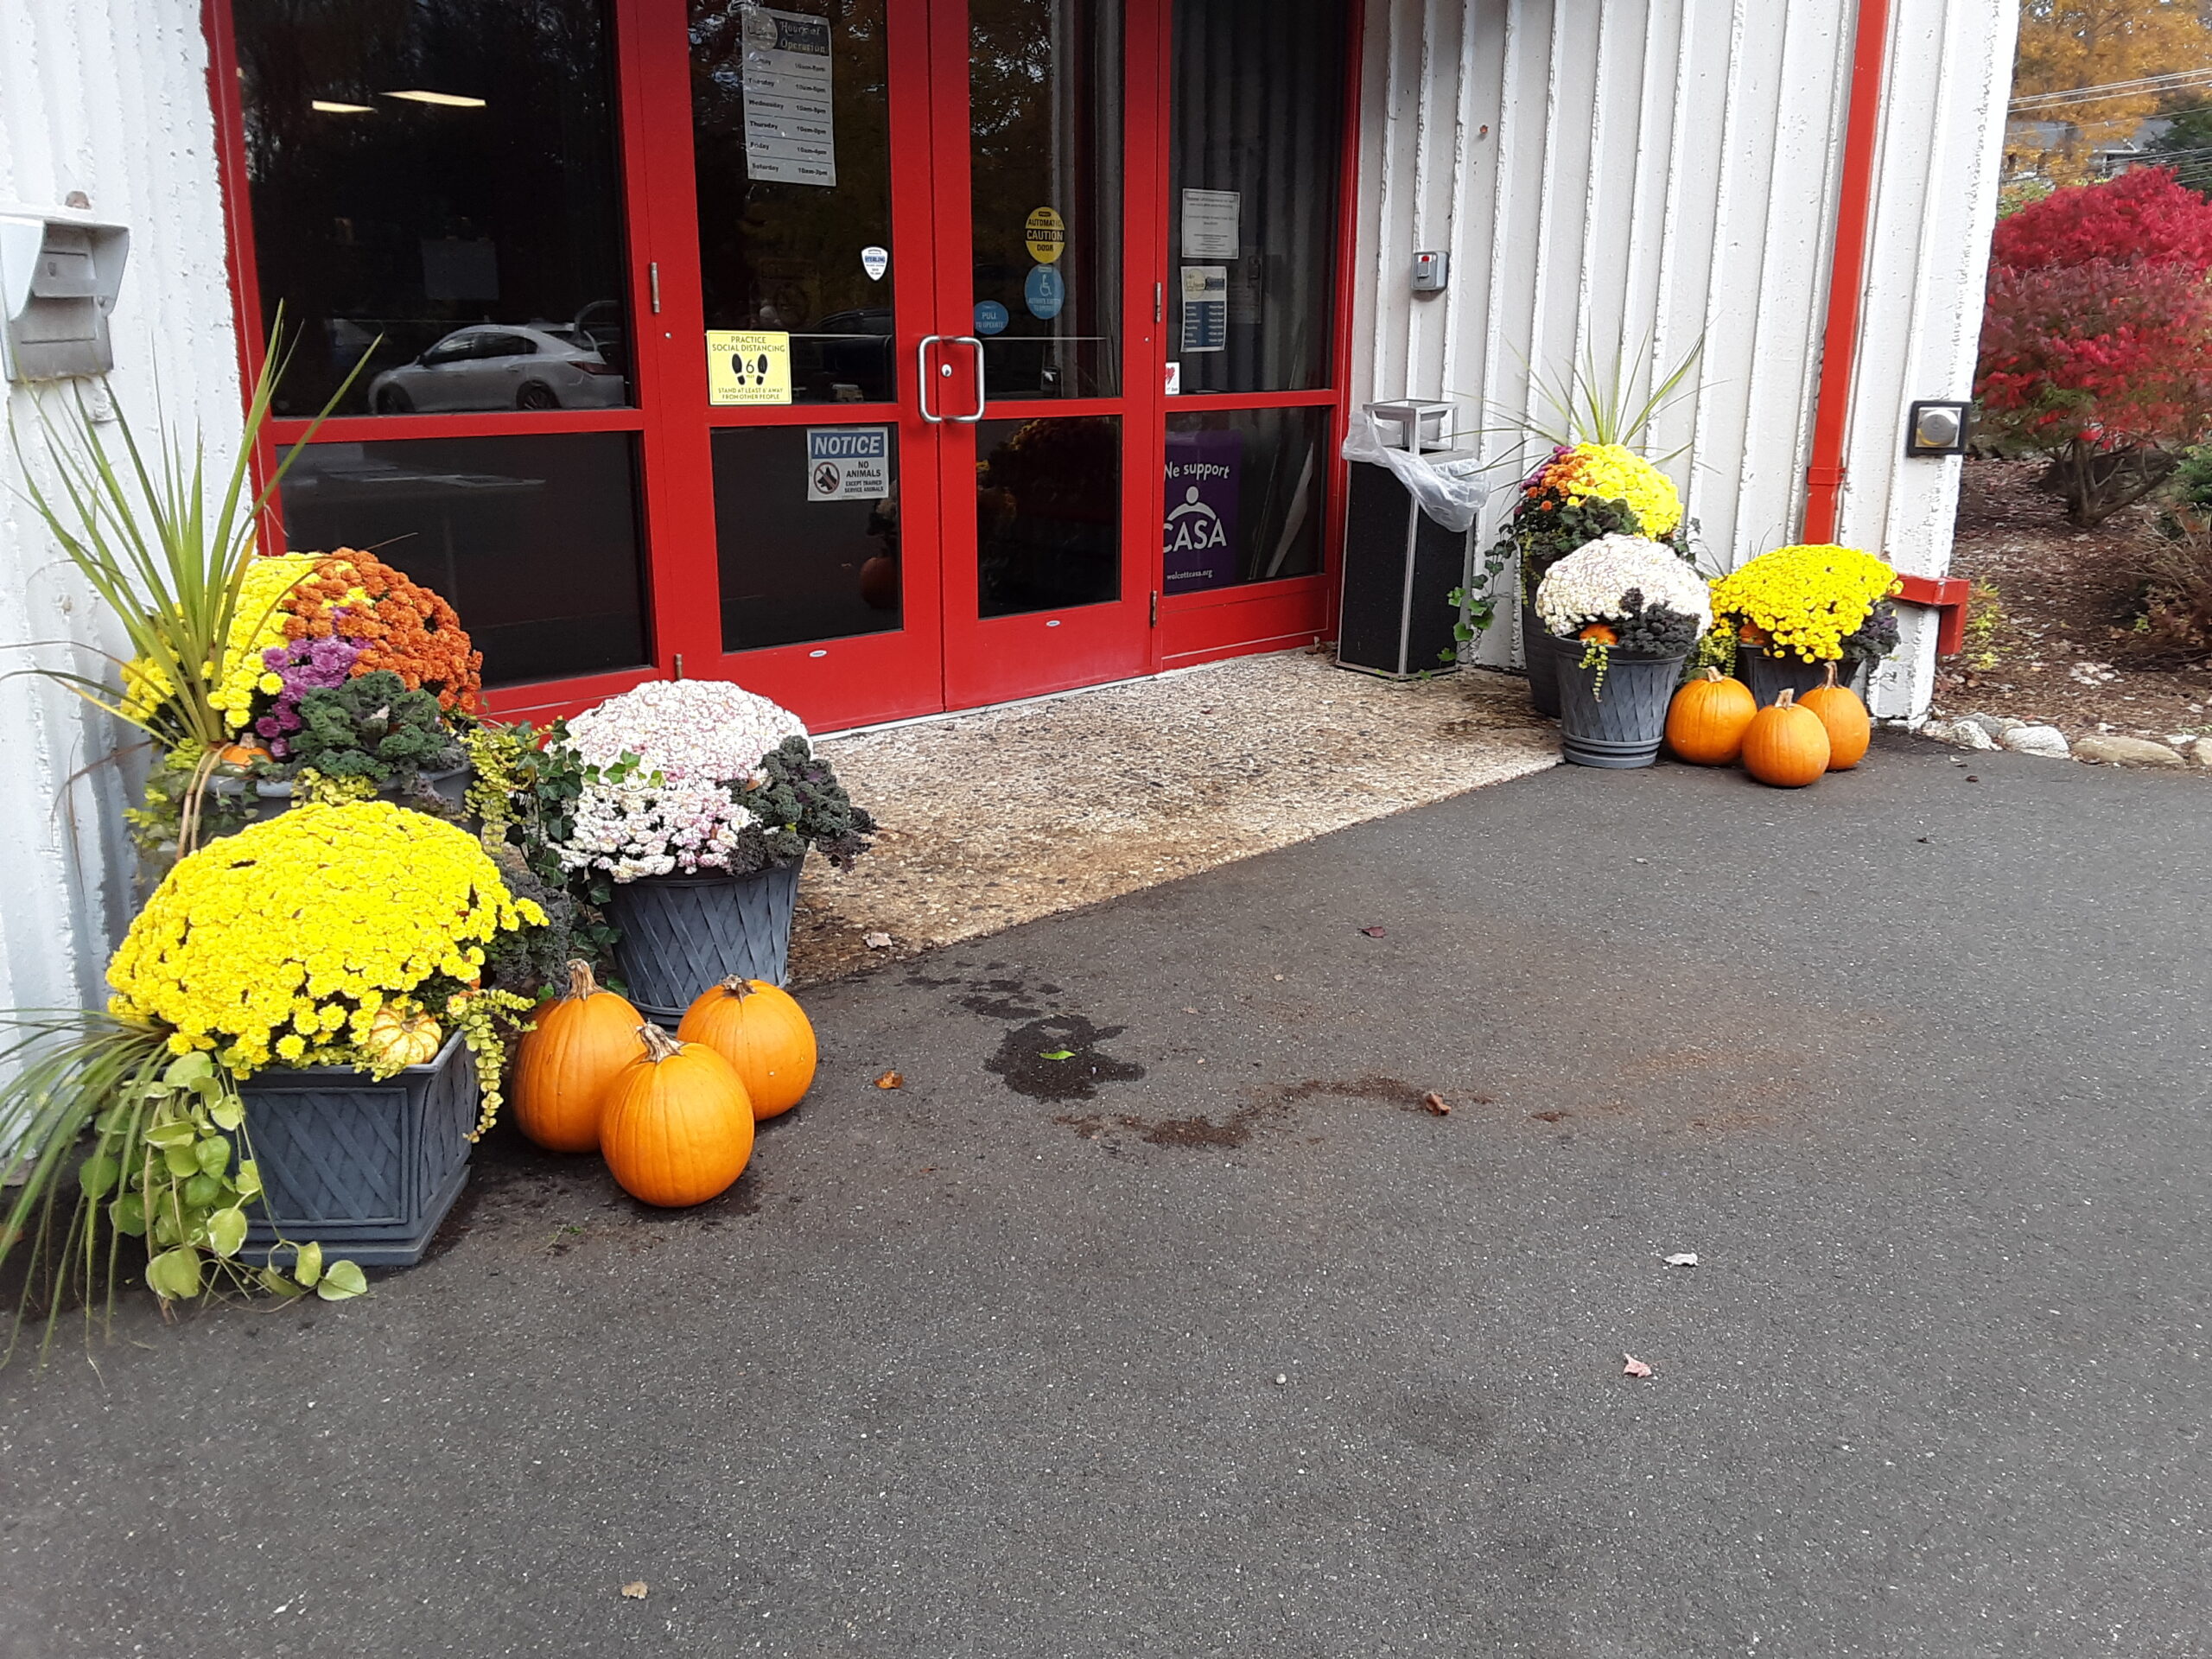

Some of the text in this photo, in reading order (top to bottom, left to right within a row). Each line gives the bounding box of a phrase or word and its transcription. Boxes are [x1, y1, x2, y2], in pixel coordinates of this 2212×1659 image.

[779, 22, 809, 35] Hours
[781, 38, 827, 53] Operation
[748, 99, 784, 110] Wednesday
[749, 120, 778, 130] Thursday
[750, 142, 769, 150] Friday
[752, 162, 779, 172] Saturday
[1027, 230, 1064, 241] CAUTION
[982, 311, 996, 320] PULL
[746, 359, 754, 374] 6
[815, 435, 881, 455] NOTICE
[846, 469, 881, 478] ANIMALS
[1184, 462, 1230, 480] support
[1166, 569, 1213, 580] wolcottcasa.org
